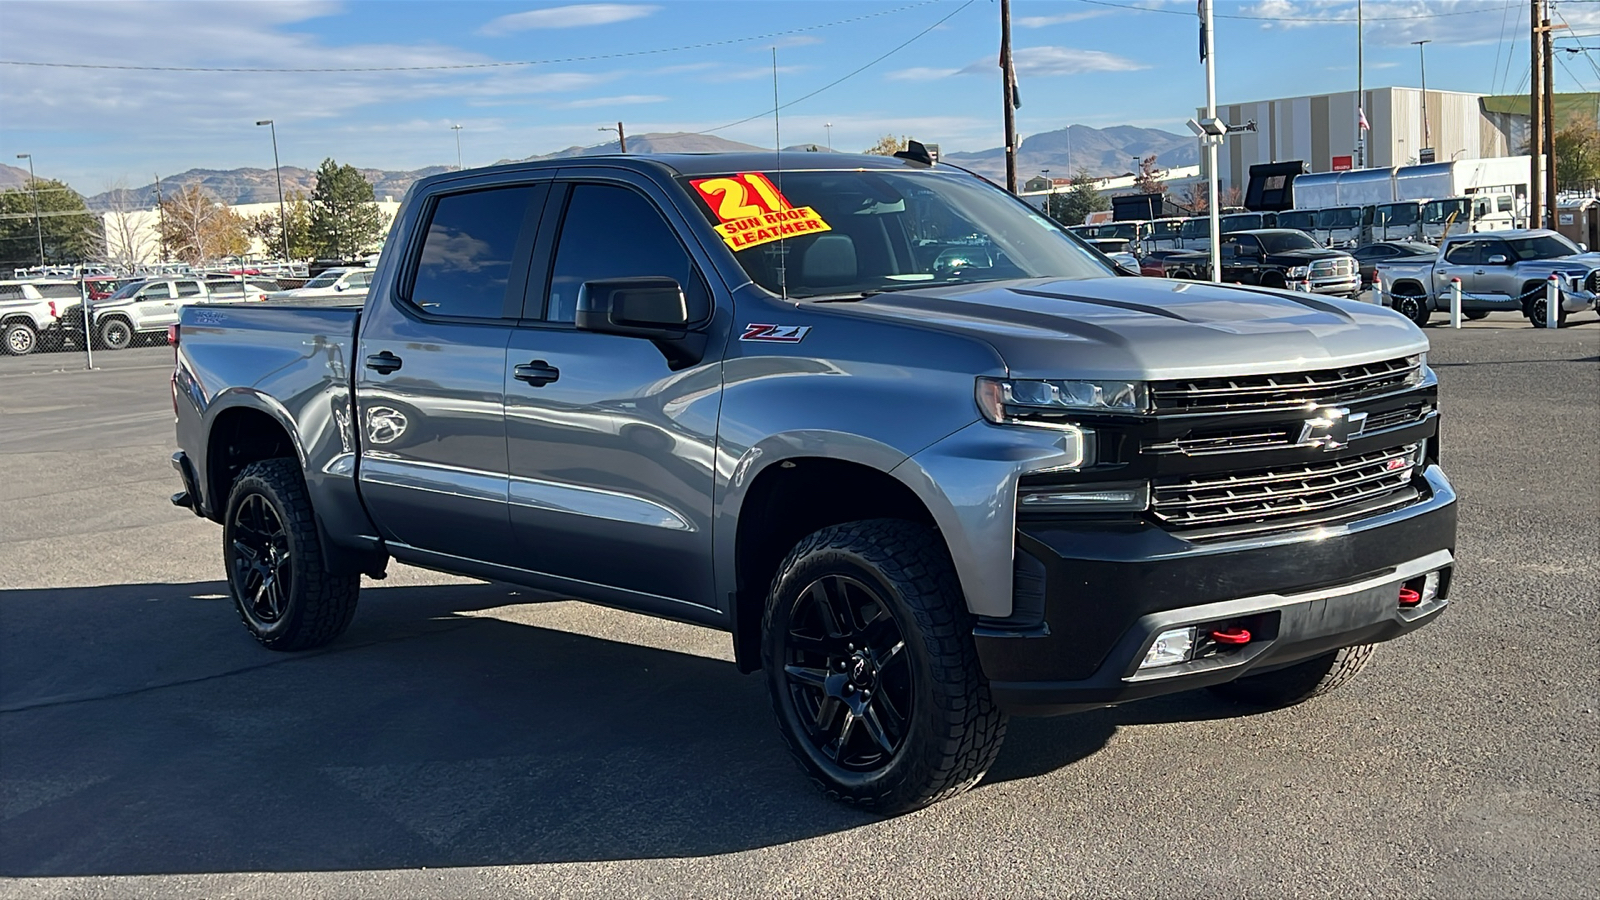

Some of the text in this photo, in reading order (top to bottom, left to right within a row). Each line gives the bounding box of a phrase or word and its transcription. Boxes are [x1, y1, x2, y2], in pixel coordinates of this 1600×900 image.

[699, 174, 785, 219] 21
[725, 208, 809, 234] SUN ROOF
[732, 220, 821, 247] LEATHER
[739, 323, 812, 343] Z71
